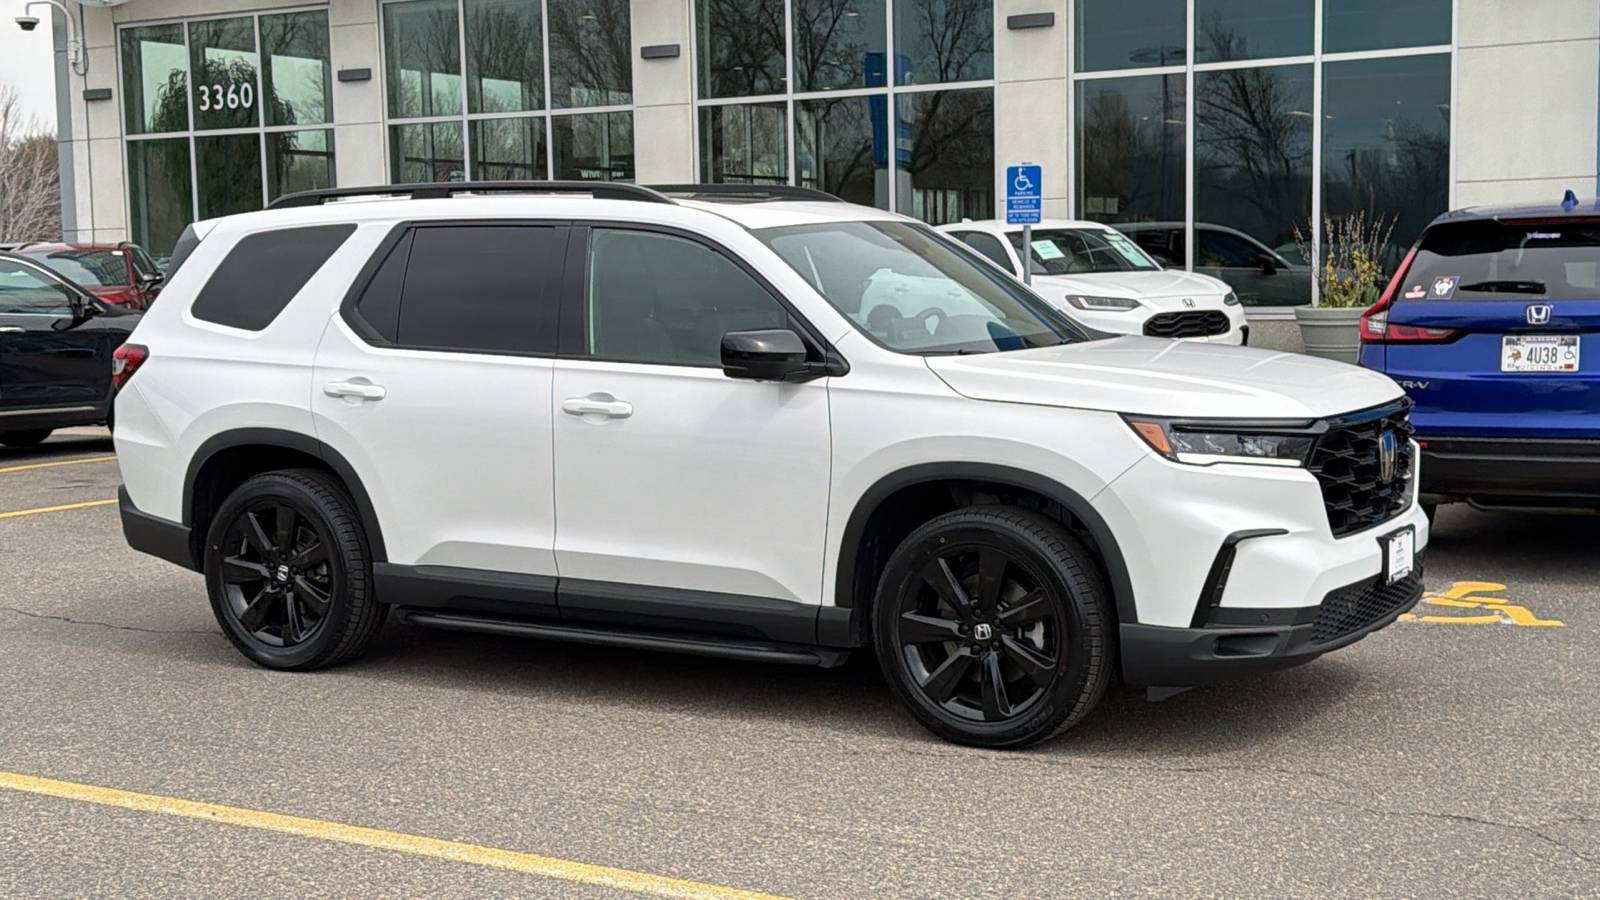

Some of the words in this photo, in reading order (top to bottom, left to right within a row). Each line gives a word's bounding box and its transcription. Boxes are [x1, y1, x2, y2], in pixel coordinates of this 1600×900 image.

[199, 82, 253, 111] 3360
[1526, 346, 1558, 364] 4U38
[1397, 380, 1430, 389] R-V
